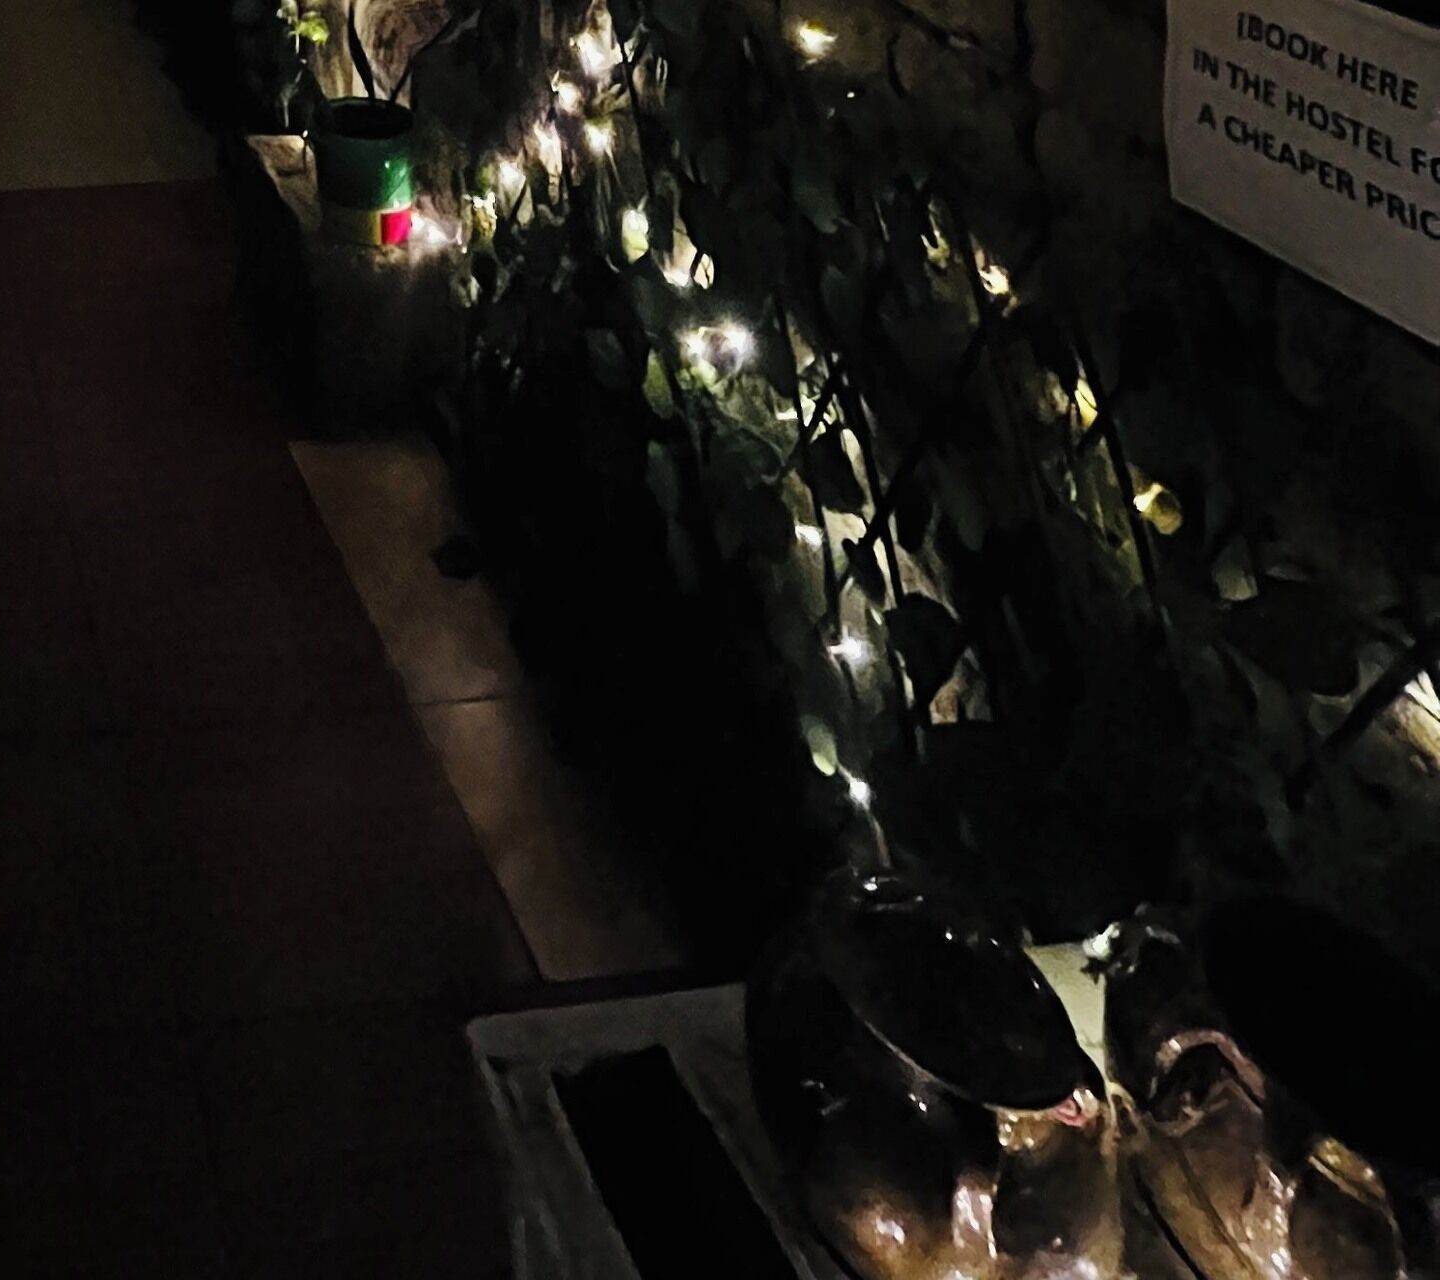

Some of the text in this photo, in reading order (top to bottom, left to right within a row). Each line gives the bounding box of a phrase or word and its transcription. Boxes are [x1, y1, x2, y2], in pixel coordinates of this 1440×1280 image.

[1192, 48, 1220, 81] IN
[1225, 60, 1276, 108] THE
[1286, 95, 1401, 167] HOSTEL
[1336, 52, 1419, 110] HERE
[1197, 102, 1217, 129] A
[1223, 114, 1356, 201] CHEAPER
